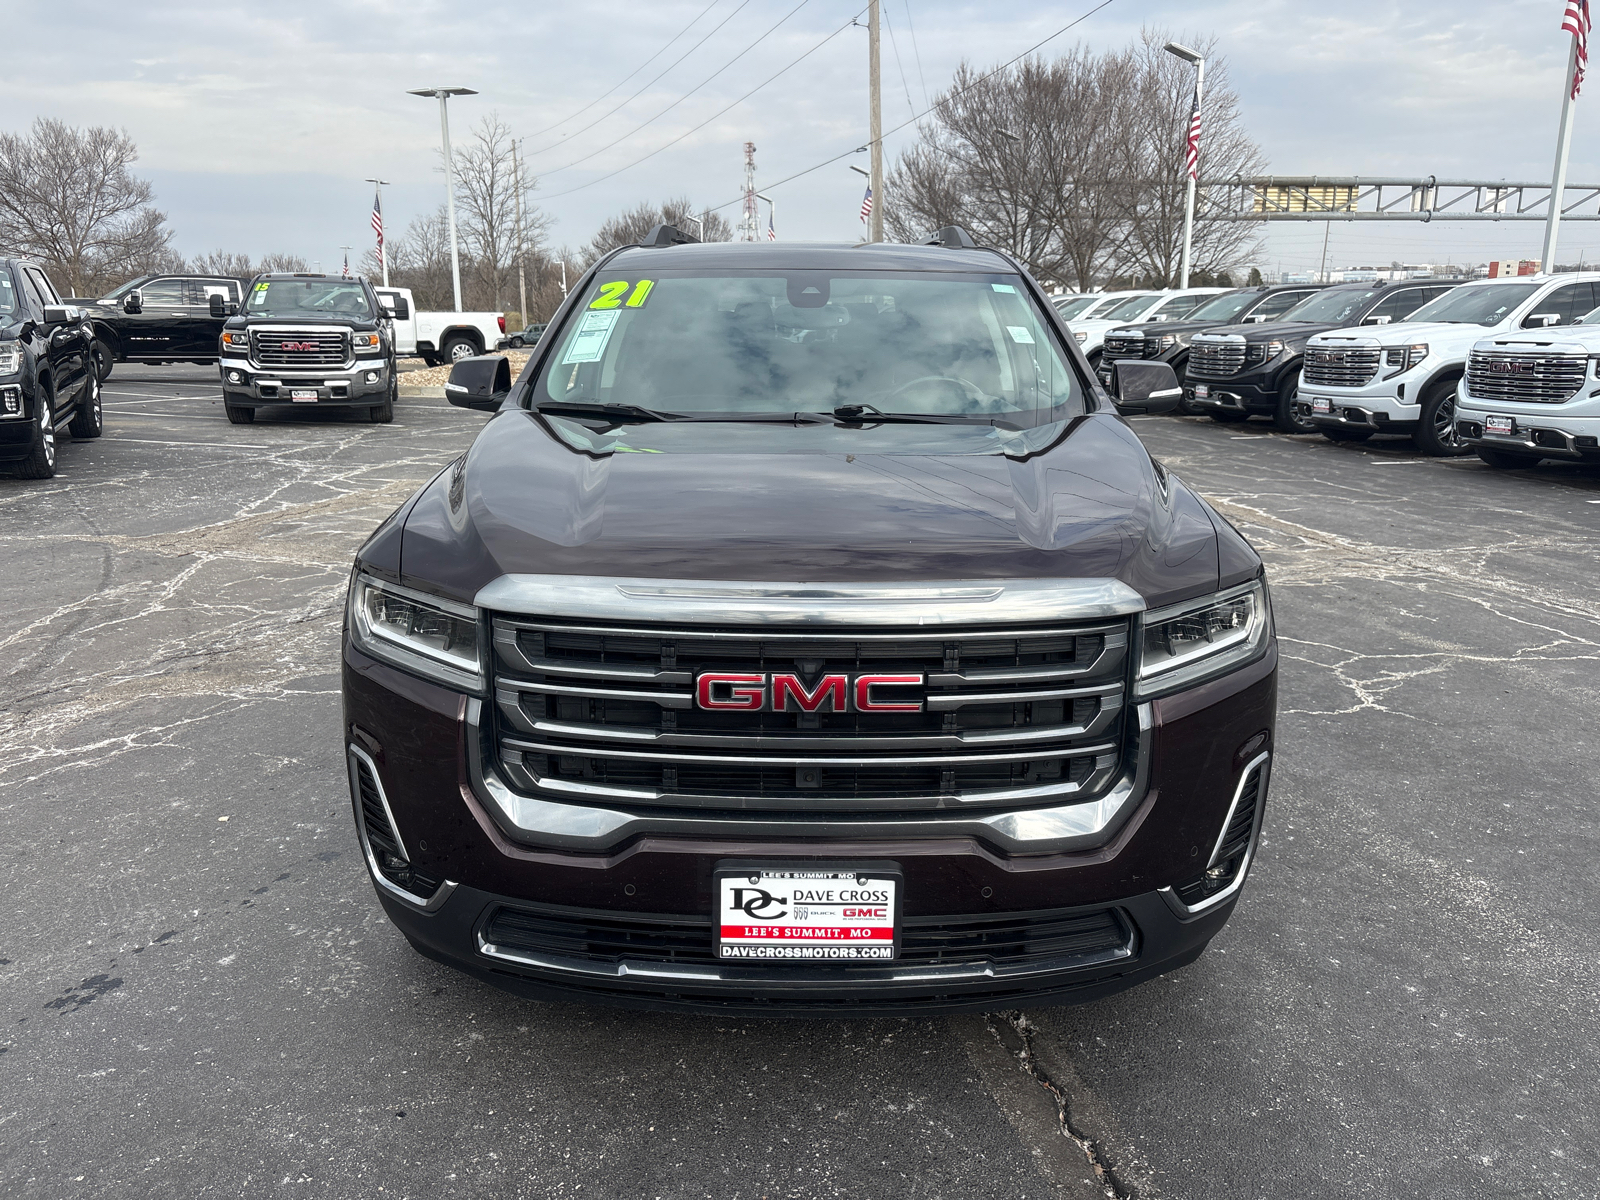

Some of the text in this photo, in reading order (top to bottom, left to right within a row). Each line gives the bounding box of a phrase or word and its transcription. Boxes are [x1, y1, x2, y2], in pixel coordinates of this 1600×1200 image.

[254, 282, 270, 291] 15
[589, 279, 655, 309] 21
[281, 341, 320, 351] GMC
[1490, 362, 1533, 374] GMC
[696, 672, 925, 713] GMC
[793, 889, 889, 902] DAVE CROSS
[842, 908, 887, 918] GMC
[784, 928, 845, 939] SUMMIT,
[849, 928, 872, 938] MO
[722, 946, 892, 958] DAVECROSSMOTORS.COM
